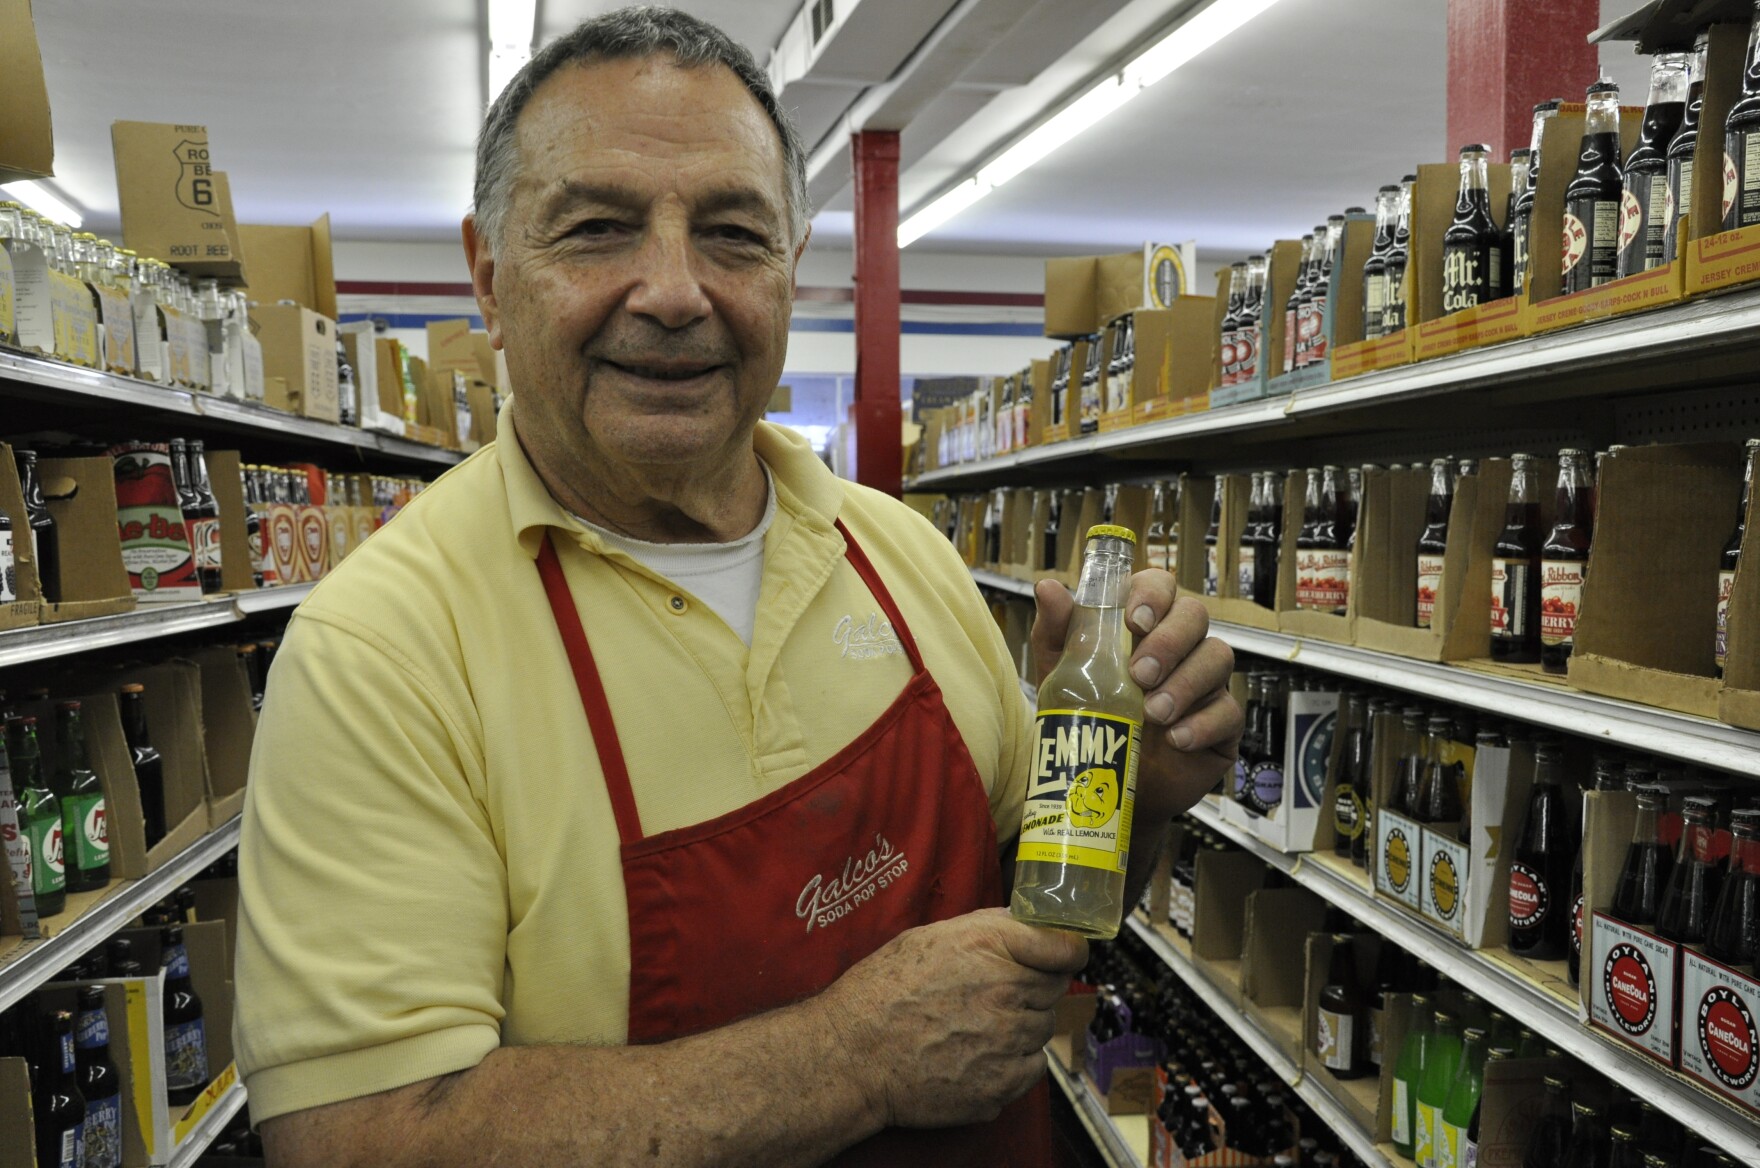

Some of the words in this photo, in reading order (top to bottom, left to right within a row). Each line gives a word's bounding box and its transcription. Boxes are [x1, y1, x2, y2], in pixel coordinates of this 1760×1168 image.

[170, 245, 198, 256] ROOT
[1704, 234, 1728, 249] 24-12
[1701, 268, 1732, 285] JERSEY
[1734, 261, 1760, 277] CREM
[1443, 290, 1478, 311] Cola
[1536, 312, 1557, 325] JERSEY
[1650, 284, 1669, 296] BULL
[1547, 566, 1580, 582] Ribbon
[10, 602, 38, 616] FRAGILE
[1027, 717, 1128, 800] LEMMY
[1057, 829, 1074, 837] REAL
[1075, 830, 1100, 839] LEMON
[1100, 832, 1116, 840] JUICE
[796, 833, 895, 933] Galco's
[817, 901, 854, 928] SODA
[853, 883, 877, 908] POP
[877, 859, 909, 889] STOP
[1603, 923, 1621, 936] NATURAL
[1622, 930, 1632, 940] WITH
[1633, 935, 1644, 945] PURE
[1644, 939, 1654, 949] CANE
[1606, 946, 1655, 993] BOYLAN
[1689, 958, 1697, 968] ALL
[1698, 962, 1717, 977] NATURAL
[1718, 972, 1730, 983] WITH
[1731, 977, 1743, 989] PURE
[1744, 984, 1756, 996] CANE
[1605, 982, 1655, 1033] BOTTLEWORKS
[1700, 989, 1757, 1044] BOYLAN
[1699, 1027, 1758, 1086] BOTTLEWORKS
